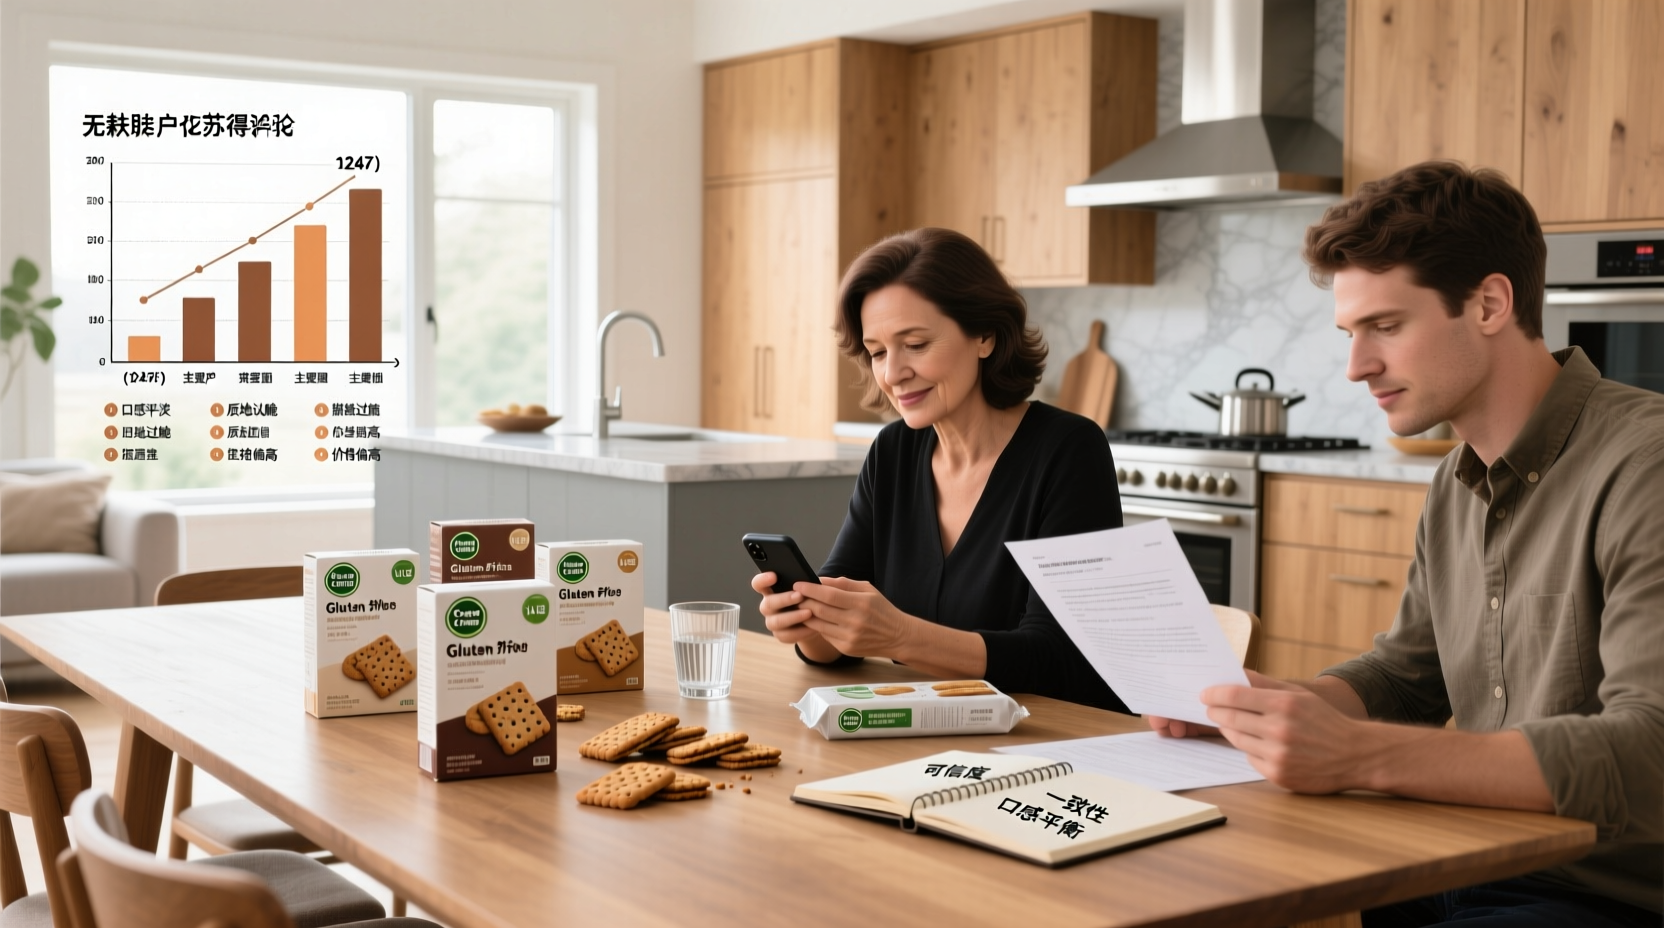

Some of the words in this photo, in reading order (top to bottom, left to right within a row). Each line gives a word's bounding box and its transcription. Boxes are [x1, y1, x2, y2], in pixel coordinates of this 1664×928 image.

[446, 642, 494, 658] Gluten
[924, 763, 992, 781] 可信度
[997, 797, 1086, 840] 口感平衡
[1046, 791, 1110, 824] 一致性
